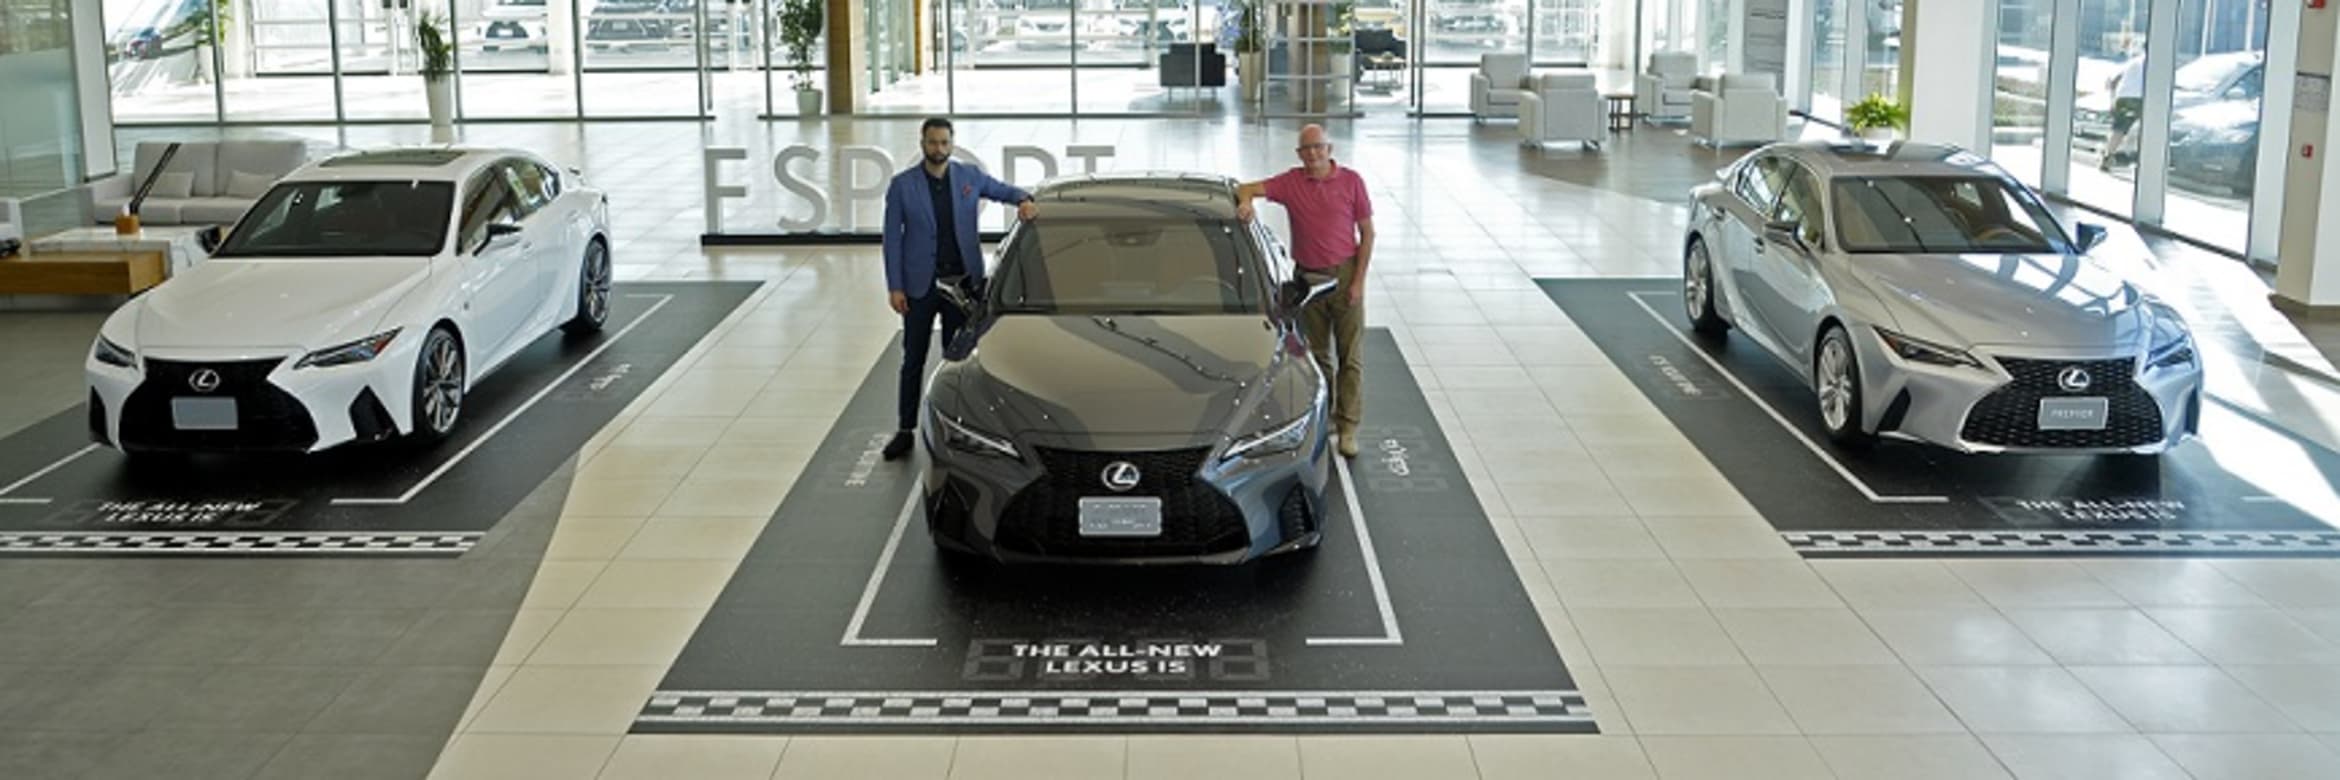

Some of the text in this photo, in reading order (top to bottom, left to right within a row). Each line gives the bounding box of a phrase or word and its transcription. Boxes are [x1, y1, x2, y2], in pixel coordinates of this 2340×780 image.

[704, 144, 1116, 234] F SPRT
[1012, 643, 1223, 658] THE ALL-NEW
[1046, 659, 1187, 674] LEXUS IS
